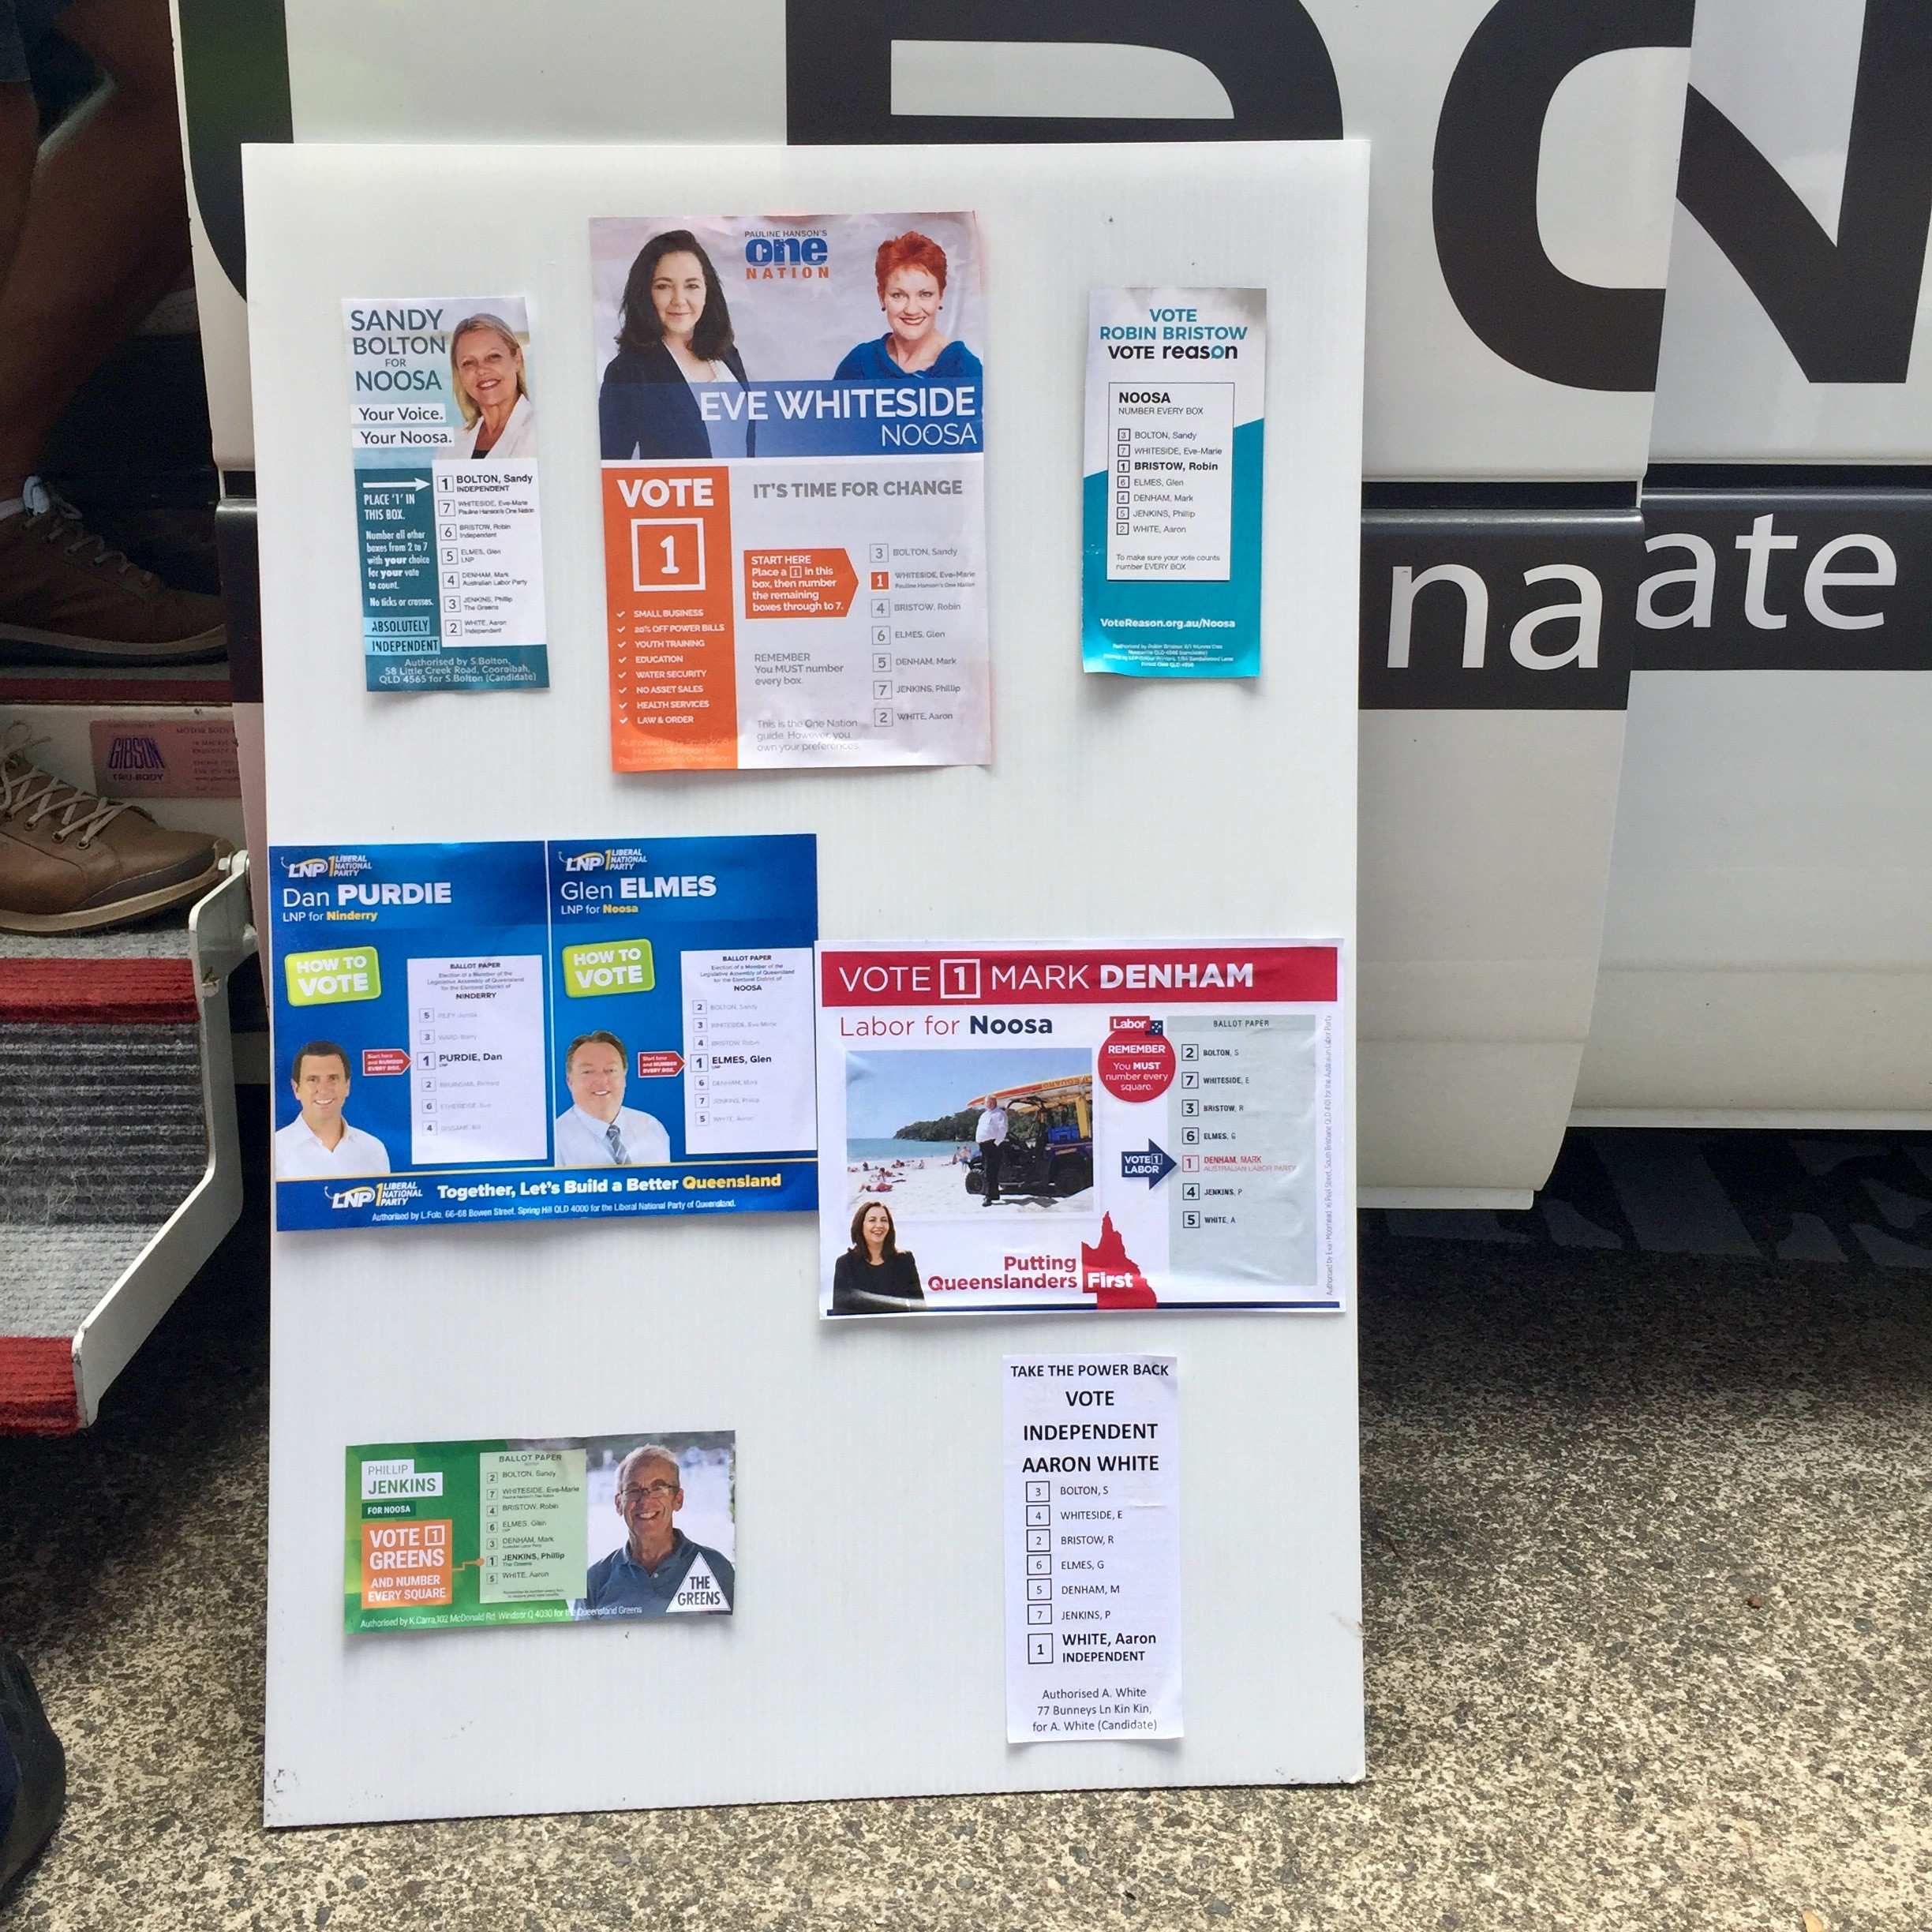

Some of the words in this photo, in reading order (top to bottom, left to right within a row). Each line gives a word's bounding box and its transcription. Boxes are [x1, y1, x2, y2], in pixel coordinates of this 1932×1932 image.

[746, 238, 828, 267] one
[746, 268, 829, 279] NATION
[351, 309, 444, 331] SANDY
[1149, 309, 1197, 322] VOTE
[1100, 327, 1156, 339] ROBIN
[1163, 327, 1248, 339] BRISTOW
[354, 336, 446, 354] BOLTON
[1108, 346, 1155, 359] VOTE
[1163, 346, 1237, 359] reason
[385, 358, 406, 367] FOR
[355, 370, 442, 391] NOOSA
[700, 391, 768, 421] EVE
[774, 386, 975, 419] WHITESIDE
[1119, 392, 1170, 403] NOOSA
[359, 408, 394, 421] Your
[398, 407, 444, 420] Voice.
[361, 431, 394, 444] Your
[400, 431, 452, 444] Noosa.
[882, 424, 977, 447] NOOSA
[1135, 462, 1185, 471] BRISTOW,
[457, 475, 500, 484] BOLTON,
[504, 474, 533, 484] Sandy
[617, 478, 714, 507] VOTE
[753, 484, 788, 499] IT'S
[792, 482, 837, 497] TIME
[842, 482, 879, 496] FOR
[883, 480, 963, 496] CHANGE
[364, 494, 389, 505] PLACE
[406, 494, 415, 504] IN
[365, 510, 384, 520] THIS
[386, 509, 405, 520] BOX.
[660, 535, 680, 575] 1
[751, 556, 783, 565] START
[786, 556, 811, 564] HERE
[634, 609, 661, 618] SMALL
[372, 621, 428, 632] ABSOLUTELY
[1100, 618, 1235, 630] VoteReason.org.au/Noosa
[372, 640, 438, 652] INDEPENDENT
[665, 639, 705, 648] TRAINING
[108, 735, 165, 769] GIBSON
[288, 863, 324, 878] LNP
[561, 882, 612, 900] Glen
[620, 874, 717, 898] ELMES
[283, 889, 329, 907] Dan
[338, 882, 451, 905] PURDIE
[561, 905, 583, 915] LNP
[586, 904, 601, 914] for
[603, 904, 638, 914] Noosa
[283, 912, 306, 923] LNP
[309, 912, 324, 921] for
[326, 911, 378, 923] Ninderry
[574, 951, 614, 966] HOW
[618, 948, 641, 960] TO
[297, 958, 339, 973] HOW
[343, 955, 367, 969] TO
[574, 964, 642, 988] VOTE
[839, 967, 931, 991] VOTE
[953, 967, 965, 990] 1
[992, 964, 1090, 990] MARK
[1100, 964, 1256, 989] DENHAM
[297, 972, 369, 996] VOTE
[841, 1017, 914, 1036] Labor
[925, 1015, 960, 1035] for
[970, 1015, 1053, 1035] Noosa
[1113, 1019, 1146, 1028] Labor
[1108, 1045, 1165, 1054] REMEMBER
[439, 1054, 481, 1062] PURDIE,
[712, 1056, 747, 1065] ELMES,
[1113, 1062, 1132, 1071] You
[1121, 1083, 1153, 1091] square.
[1125, 1155, 1150, 1164] VOTE
[1125, 1165, 1159, 1174] LABOR
[437, 1185, 515, 1201] Together,
[520, 1181, 560, 1196] Let's
[564, 1180, 608, 1194] Build
[612, 1182, 623, 1192] a
[627, 1178, 678, 1191] Better
[682, 1174, 781, 1189] Queensland
[1004, 1256, 1076, 1272] Putting
[928, 1273, 1077, 1290] Queenslanders
[1088, 1272, 1133, 1288] First
[1011, 1365, 1044, 1376] TAKE
[1048, 1365, 1074, 1376] THE
[1078, 1365, 1129, 1376] POWER
[1133, 1365, 1169, 1375] BACK
[1065, 1391, 1114, 1406] VOTE
[1024, 1424, 1158, 1440] INDEPENDENT
[368, 1465, 408, 1475] PHILLIP
[1022, 1457, 1091, 1473] AARON
[1097, 1455, 1159, 1471] WHITE
[369, 1478, 436, 1495] JENKINS
[368, 1506, 382, 1515] FOR
[384, 1505, 410, 1514] NOOSA
[370, 1528, 420, 1548] VOTE
[431, 1530, 438, 1542] 1
[369, 1548, 444, 1570] GREENS
[371, 1578, 393, 1588] AND
[396, 1575, 440, 1586] NUMBER
[690, 1576, 710, 1589] THE
[368, 1591, 401, 1602] EVERY
[404, 1588, 446, 1600] SQUARE
[677, 1591, 721, 1605] GREENS
[1062, 1634, 1111, 1647] WHITE,
[1115, 1633, 1156, 1645] Aaron
[1063, 1651, 1145, 1663] INDEPENDENT
[1042, 1689, 1099, 1699] Authorised
[1103, 1689, 1112, 1698] A.
[1116, 1688, 1147, 1697] White
[1038, 1706, 1050, 1715] 77
[1054, 1705, 1096, 1716] Bunneys
[1114, 1705, 1130, 1713] Kin
[1133, 1705, 1152, 1714] Kin,
[1033, 1722, 1047, 1732] for
[1064, 1722, 1095, 1731] White
[1098, 1719, 1158, 1732] (Candidate)
